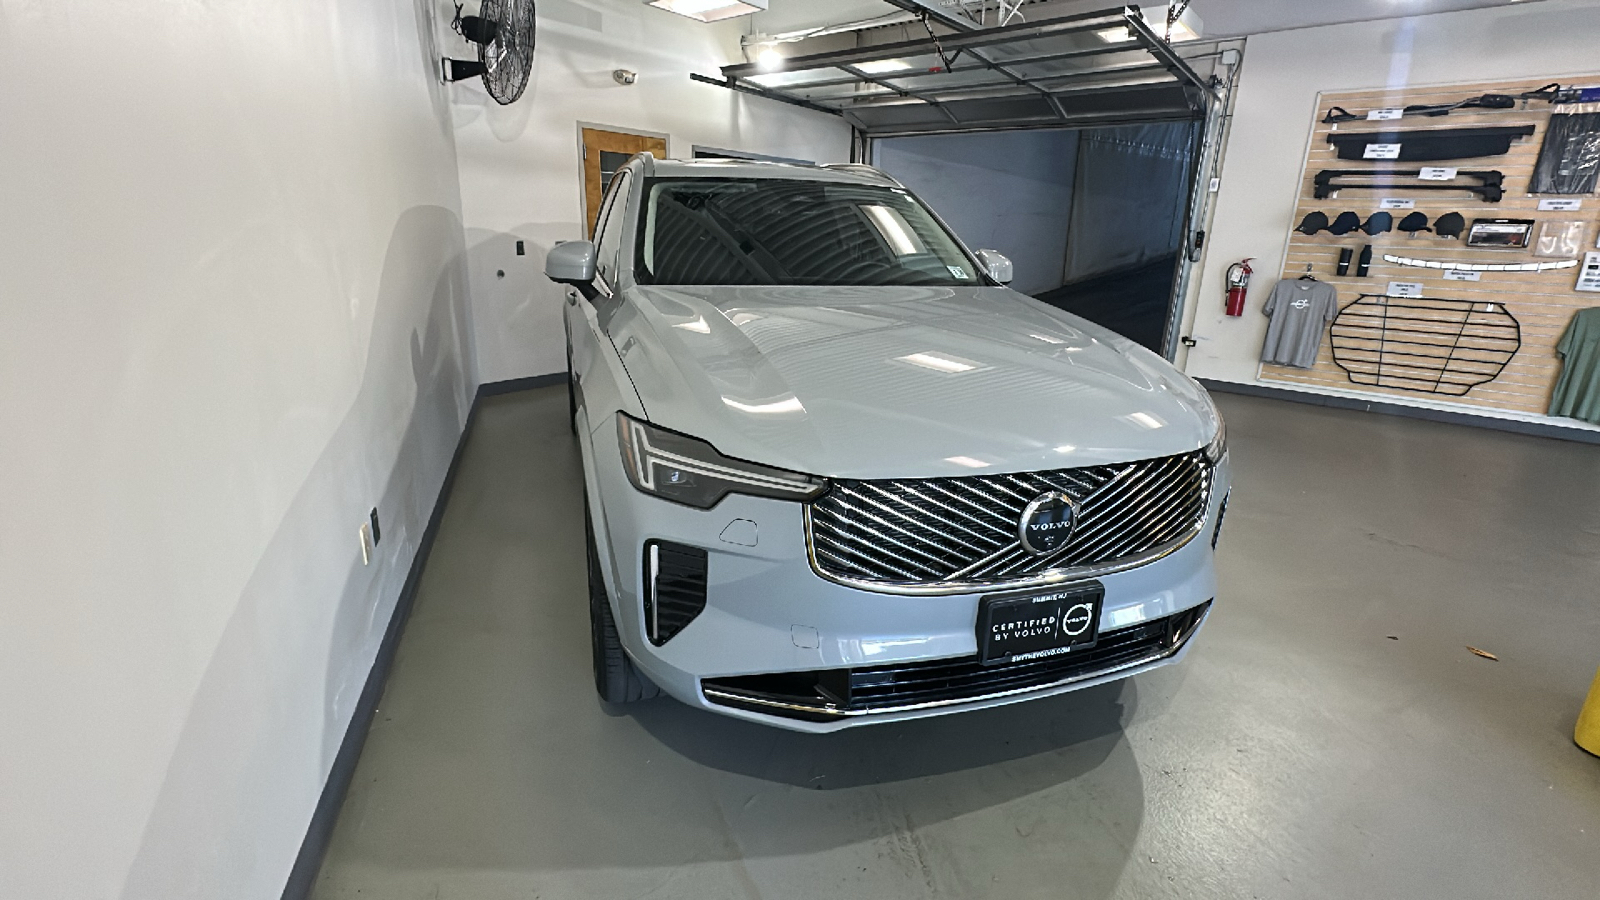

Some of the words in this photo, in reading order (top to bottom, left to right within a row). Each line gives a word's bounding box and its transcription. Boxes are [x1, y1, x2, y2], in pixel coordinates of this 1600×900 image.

[1030, 521, 1071, 531] VOLVO
[992, 616, 1055, 632] CERTIFIED
[1067, 616, 1088, 624] VOLVO
[994, 632, 1009, 641] BY
[1014, 626, 1051, 638] VOLVO
